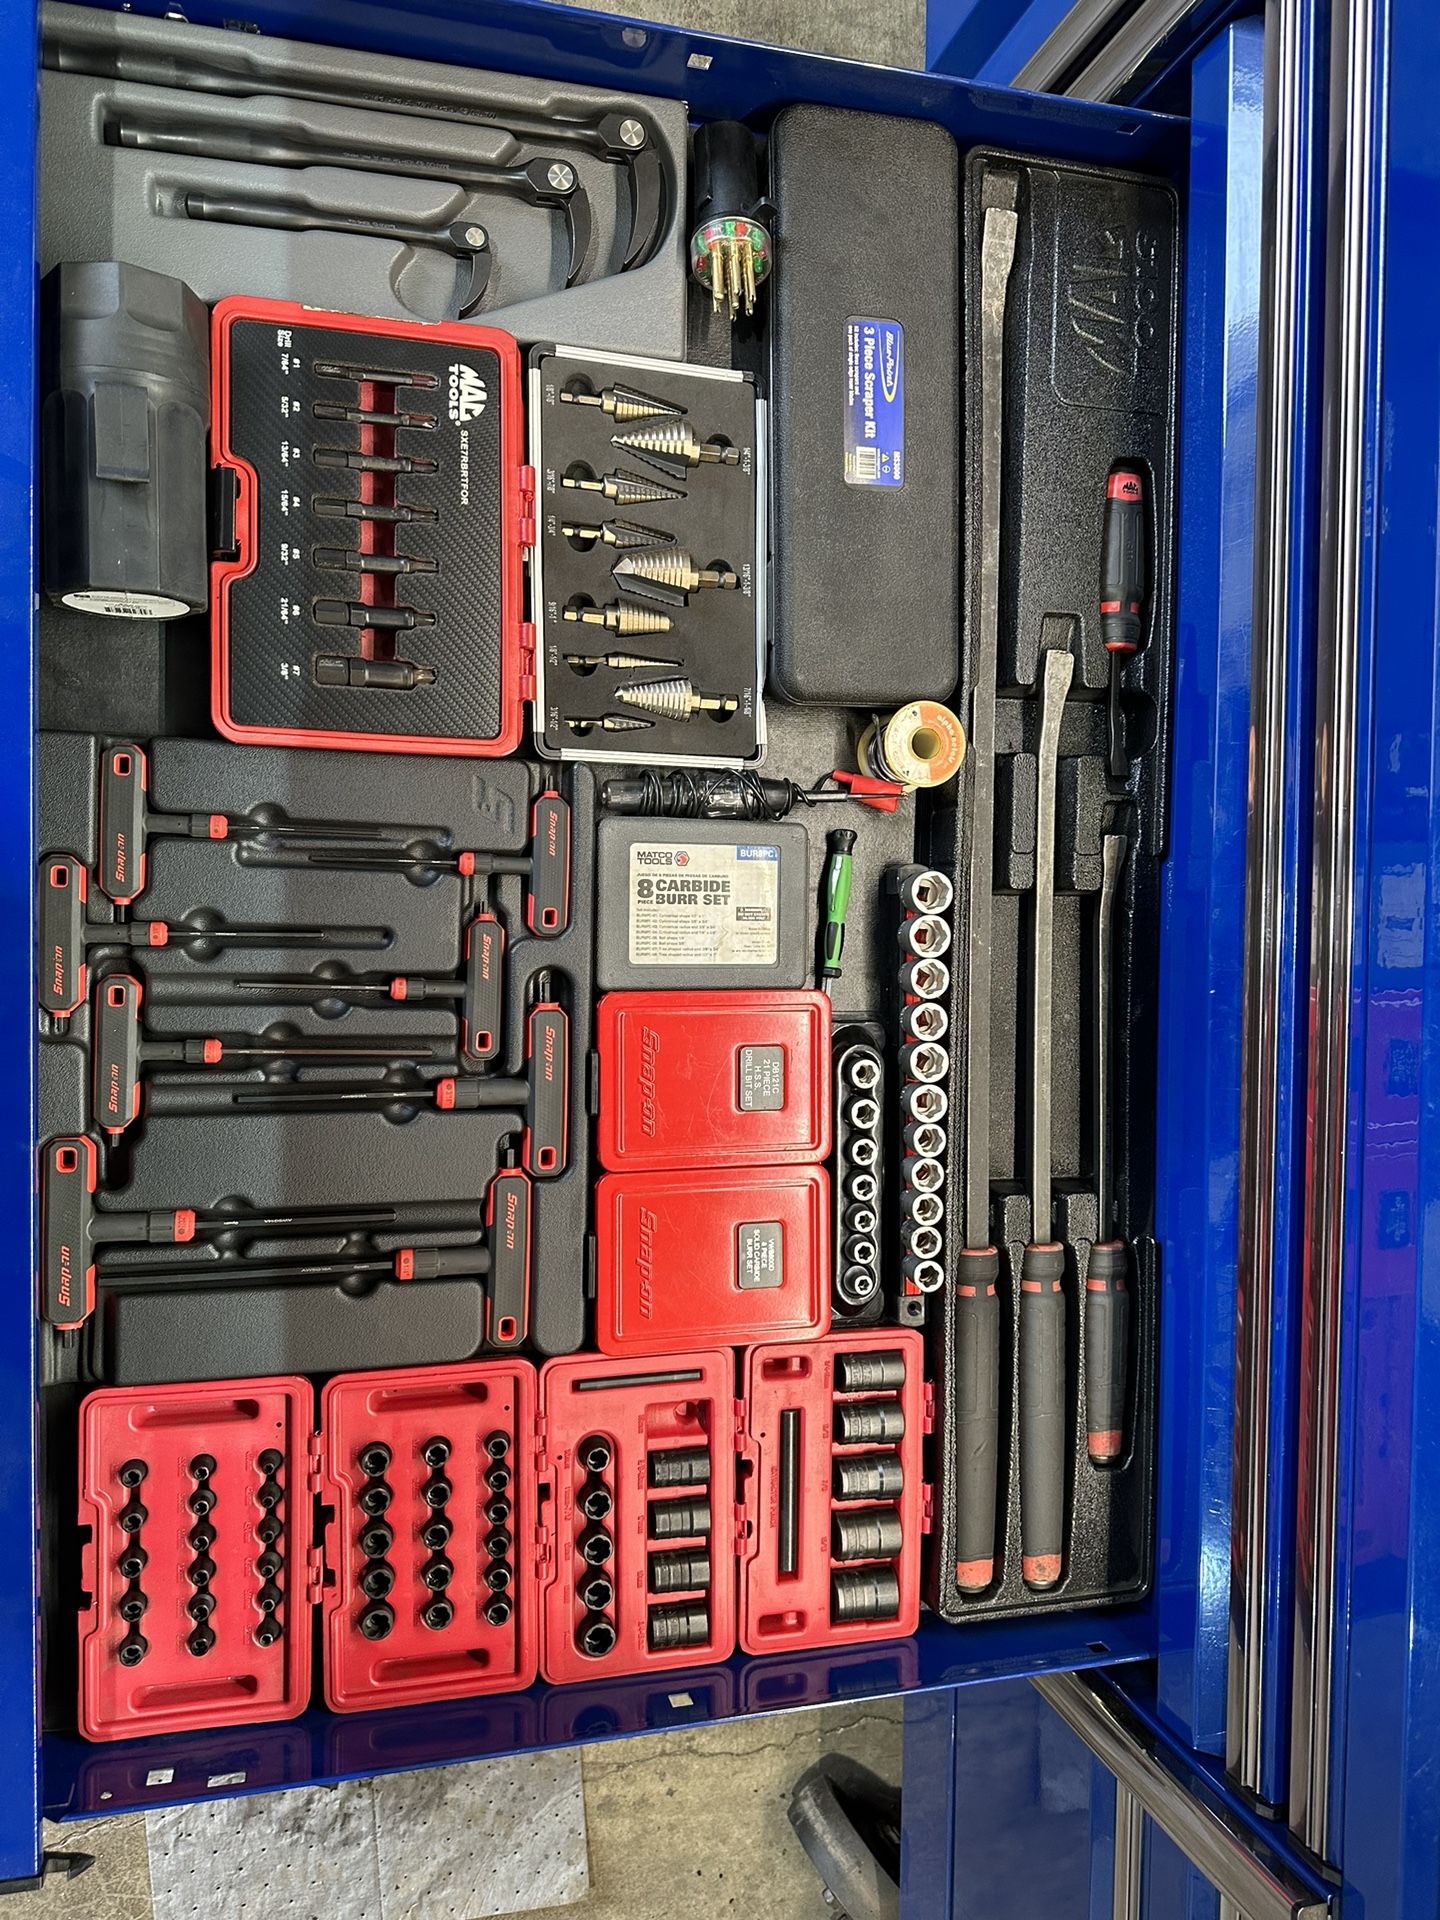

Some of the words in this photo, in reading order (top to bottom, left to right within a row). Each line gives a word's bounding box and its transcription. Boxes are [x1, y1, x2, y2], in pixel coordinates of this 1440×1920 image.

[284, 330, 292, 348] Drill
[863, 326, 875, 334] 3
[281, 353, 289, 375] 7/64"
[293, 358, 300, 368] #1
[864, 338, 876, 370] Piece
[448, 363, 459, 420] TOOLS
[459, 363, 487, 421] MAC
[862, 372, 876, 419] Scraper
[281, 396, 289, 418] 5/32"
[293, 401, 300, 412] #2
[864, 421, 876, 438] Kit
[281, 441, 289, 467] 13/64"
[293, 447, 300, 459] #3
[460, 430, 468, 505] SXE7RBRTFOR
[281, 489, 289, 516] 15/64"
[293, 496, 300, 507] #4
[280, 543, 289, 566] 9/32"
[292, 548, 300, 560] #5
[280, 597, 289, 625] 21/64"
[292, 605, 300, 616] #6
[280, 662, 289, 680] 3/8"
[292, 664, 300, 676] #7
[548, 810, 558, 857] Snap-on
[115, 832, 126, 882] Snap-on
[637, 858, 672, 866] TOOLS
[637, 878, 654, 898] 8
[656, 879, 730, 892] CARBIDE
[656, 894, 698, 904] BURR
[703, 894, 730, 905] SET
[480, 934, 492, 980] Snap-on
[53, 946, 64, 996] Snap-on
[544, 1025, 556, 1081] Snap-on
[744, 1050, 753, 1073] DRILL
[762, 1058, 771, 1069] 21
[108, 1064, 119, 1113] Snap-on
[638, 1026, 660, 1138] Snap-on
[744, 1075, 753, 1089] BIT
[754, 1065, 762, 1090] H.S.S.
[762, 1071, 771, 1097] PIECE
[772, 1061, 780, 1094] DB121C
[744, 1090, 753, 1108] SET
[506, 1192, 518, 1250] Snap-on
[635, 1206, 658, 1320] Snap-on
[58, 1245, 72, 1307] Snap-on
